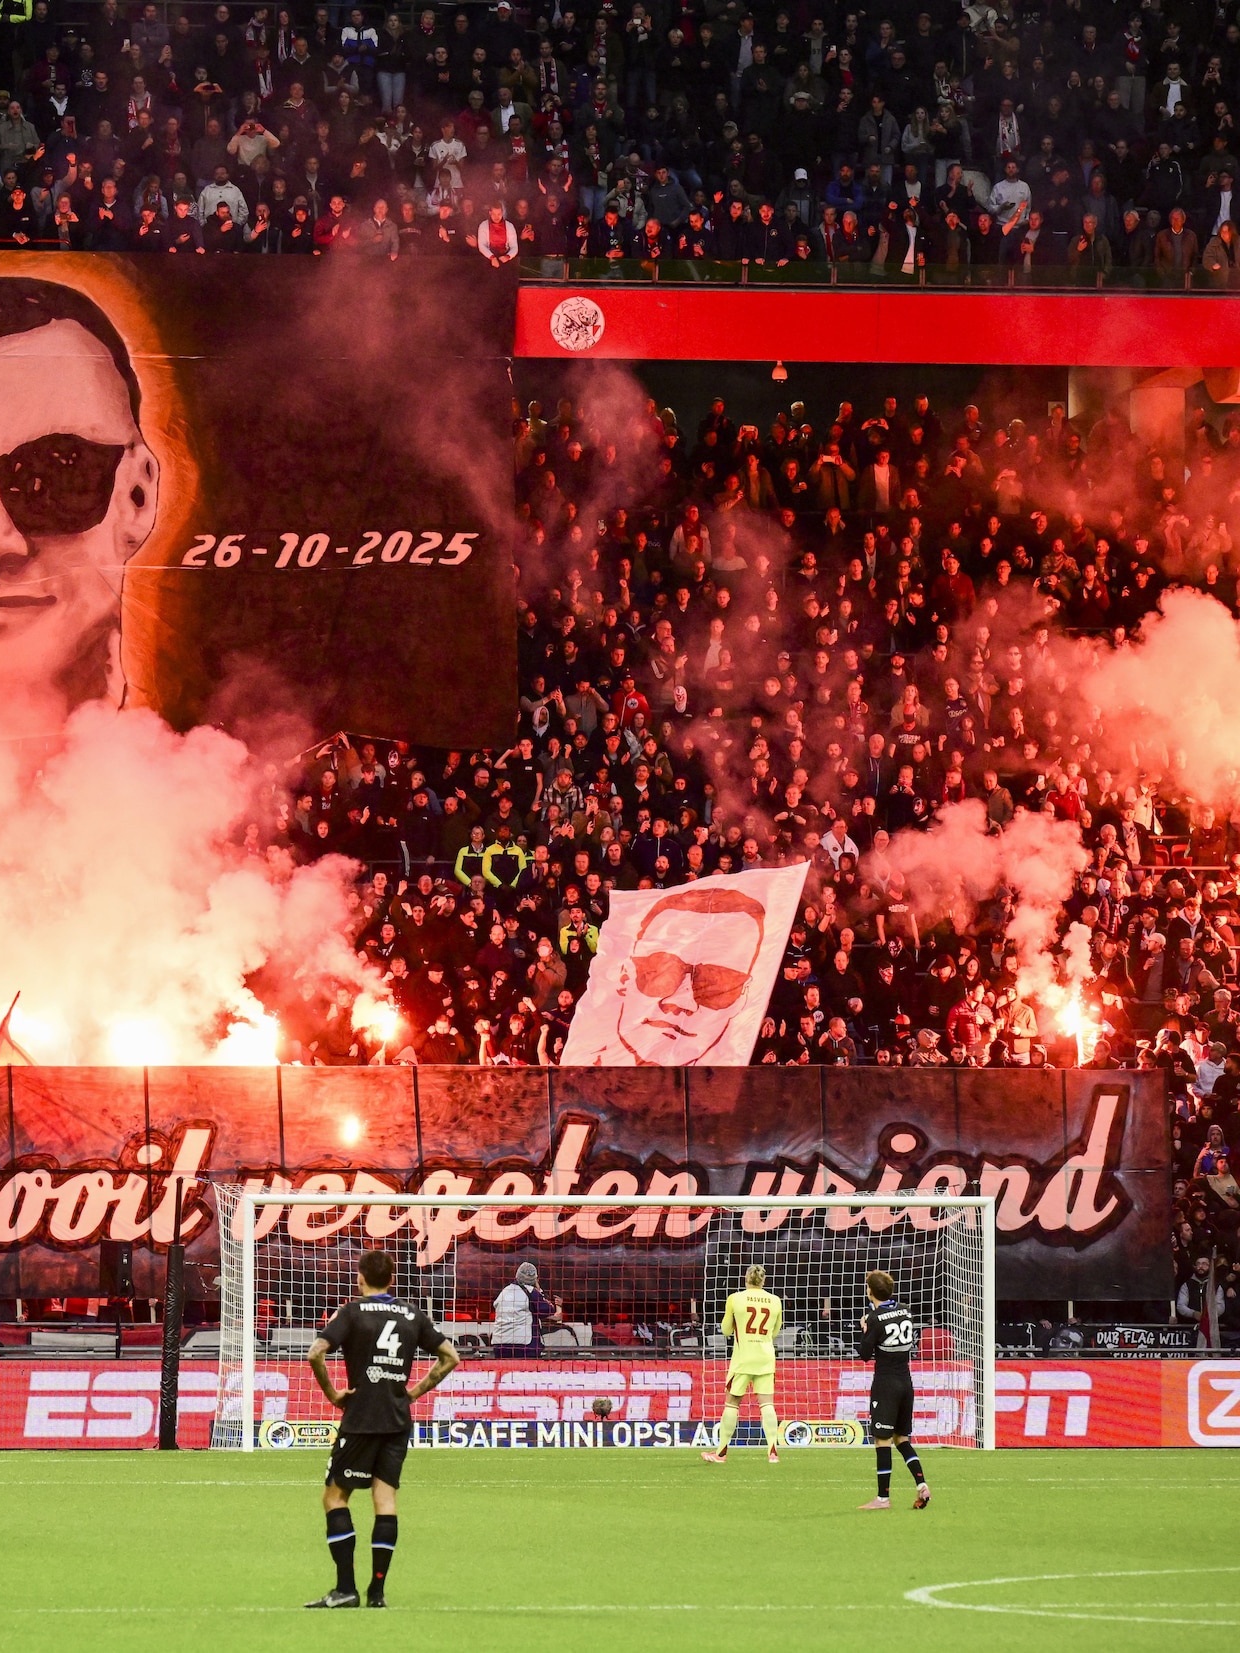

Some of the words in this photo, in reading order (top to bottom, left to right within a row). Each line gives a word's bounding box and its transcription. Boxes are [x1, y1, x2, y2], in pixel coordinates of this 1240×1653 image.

[238, 1122, 712, 1267] vergeten
[743, 1094, 1119, 1234] vriend
[745, 1306, 771, 1336] 22
[881, 1319, 913, 1347] 20
[376, 1319, 403, 1358] 4
[1124, 1331, 1156, 1345] FLAG
[1159, 1332, 1190, 1346] WILL
[23, 1371, 289, 1438] ESPN
[432, 1371, 692, 1421] ESPN
[300, 1427, 328, 1436] ALLSAFE
[407, 1421, 528, 1448] LLSAFE
[537, 1421, 603, 1448] MINI
[817, 1426, 845, 1436] ALLSAFE
